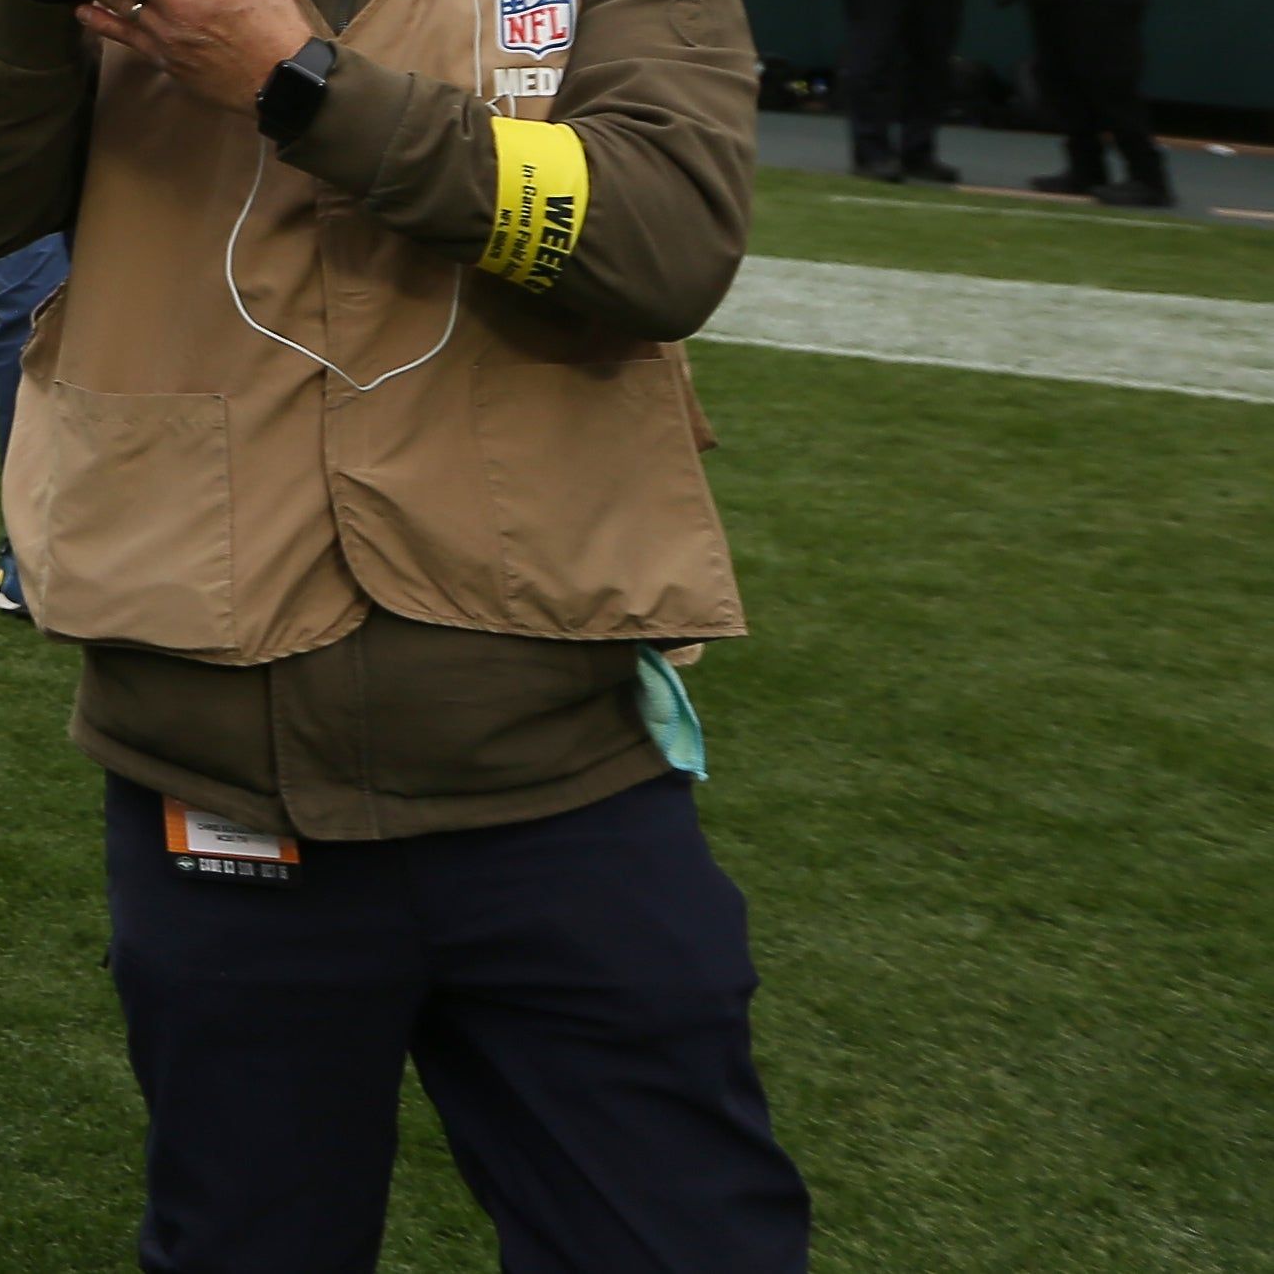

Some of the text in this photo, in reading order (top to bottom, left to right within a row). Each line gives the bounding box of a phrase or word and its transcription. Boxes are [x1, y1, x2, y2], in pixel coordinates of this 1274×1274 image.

[506, 6, 567, 45] NFL
[518, 164, 537, 228] In-Game
[529, 196, 574, 280] WEEK
